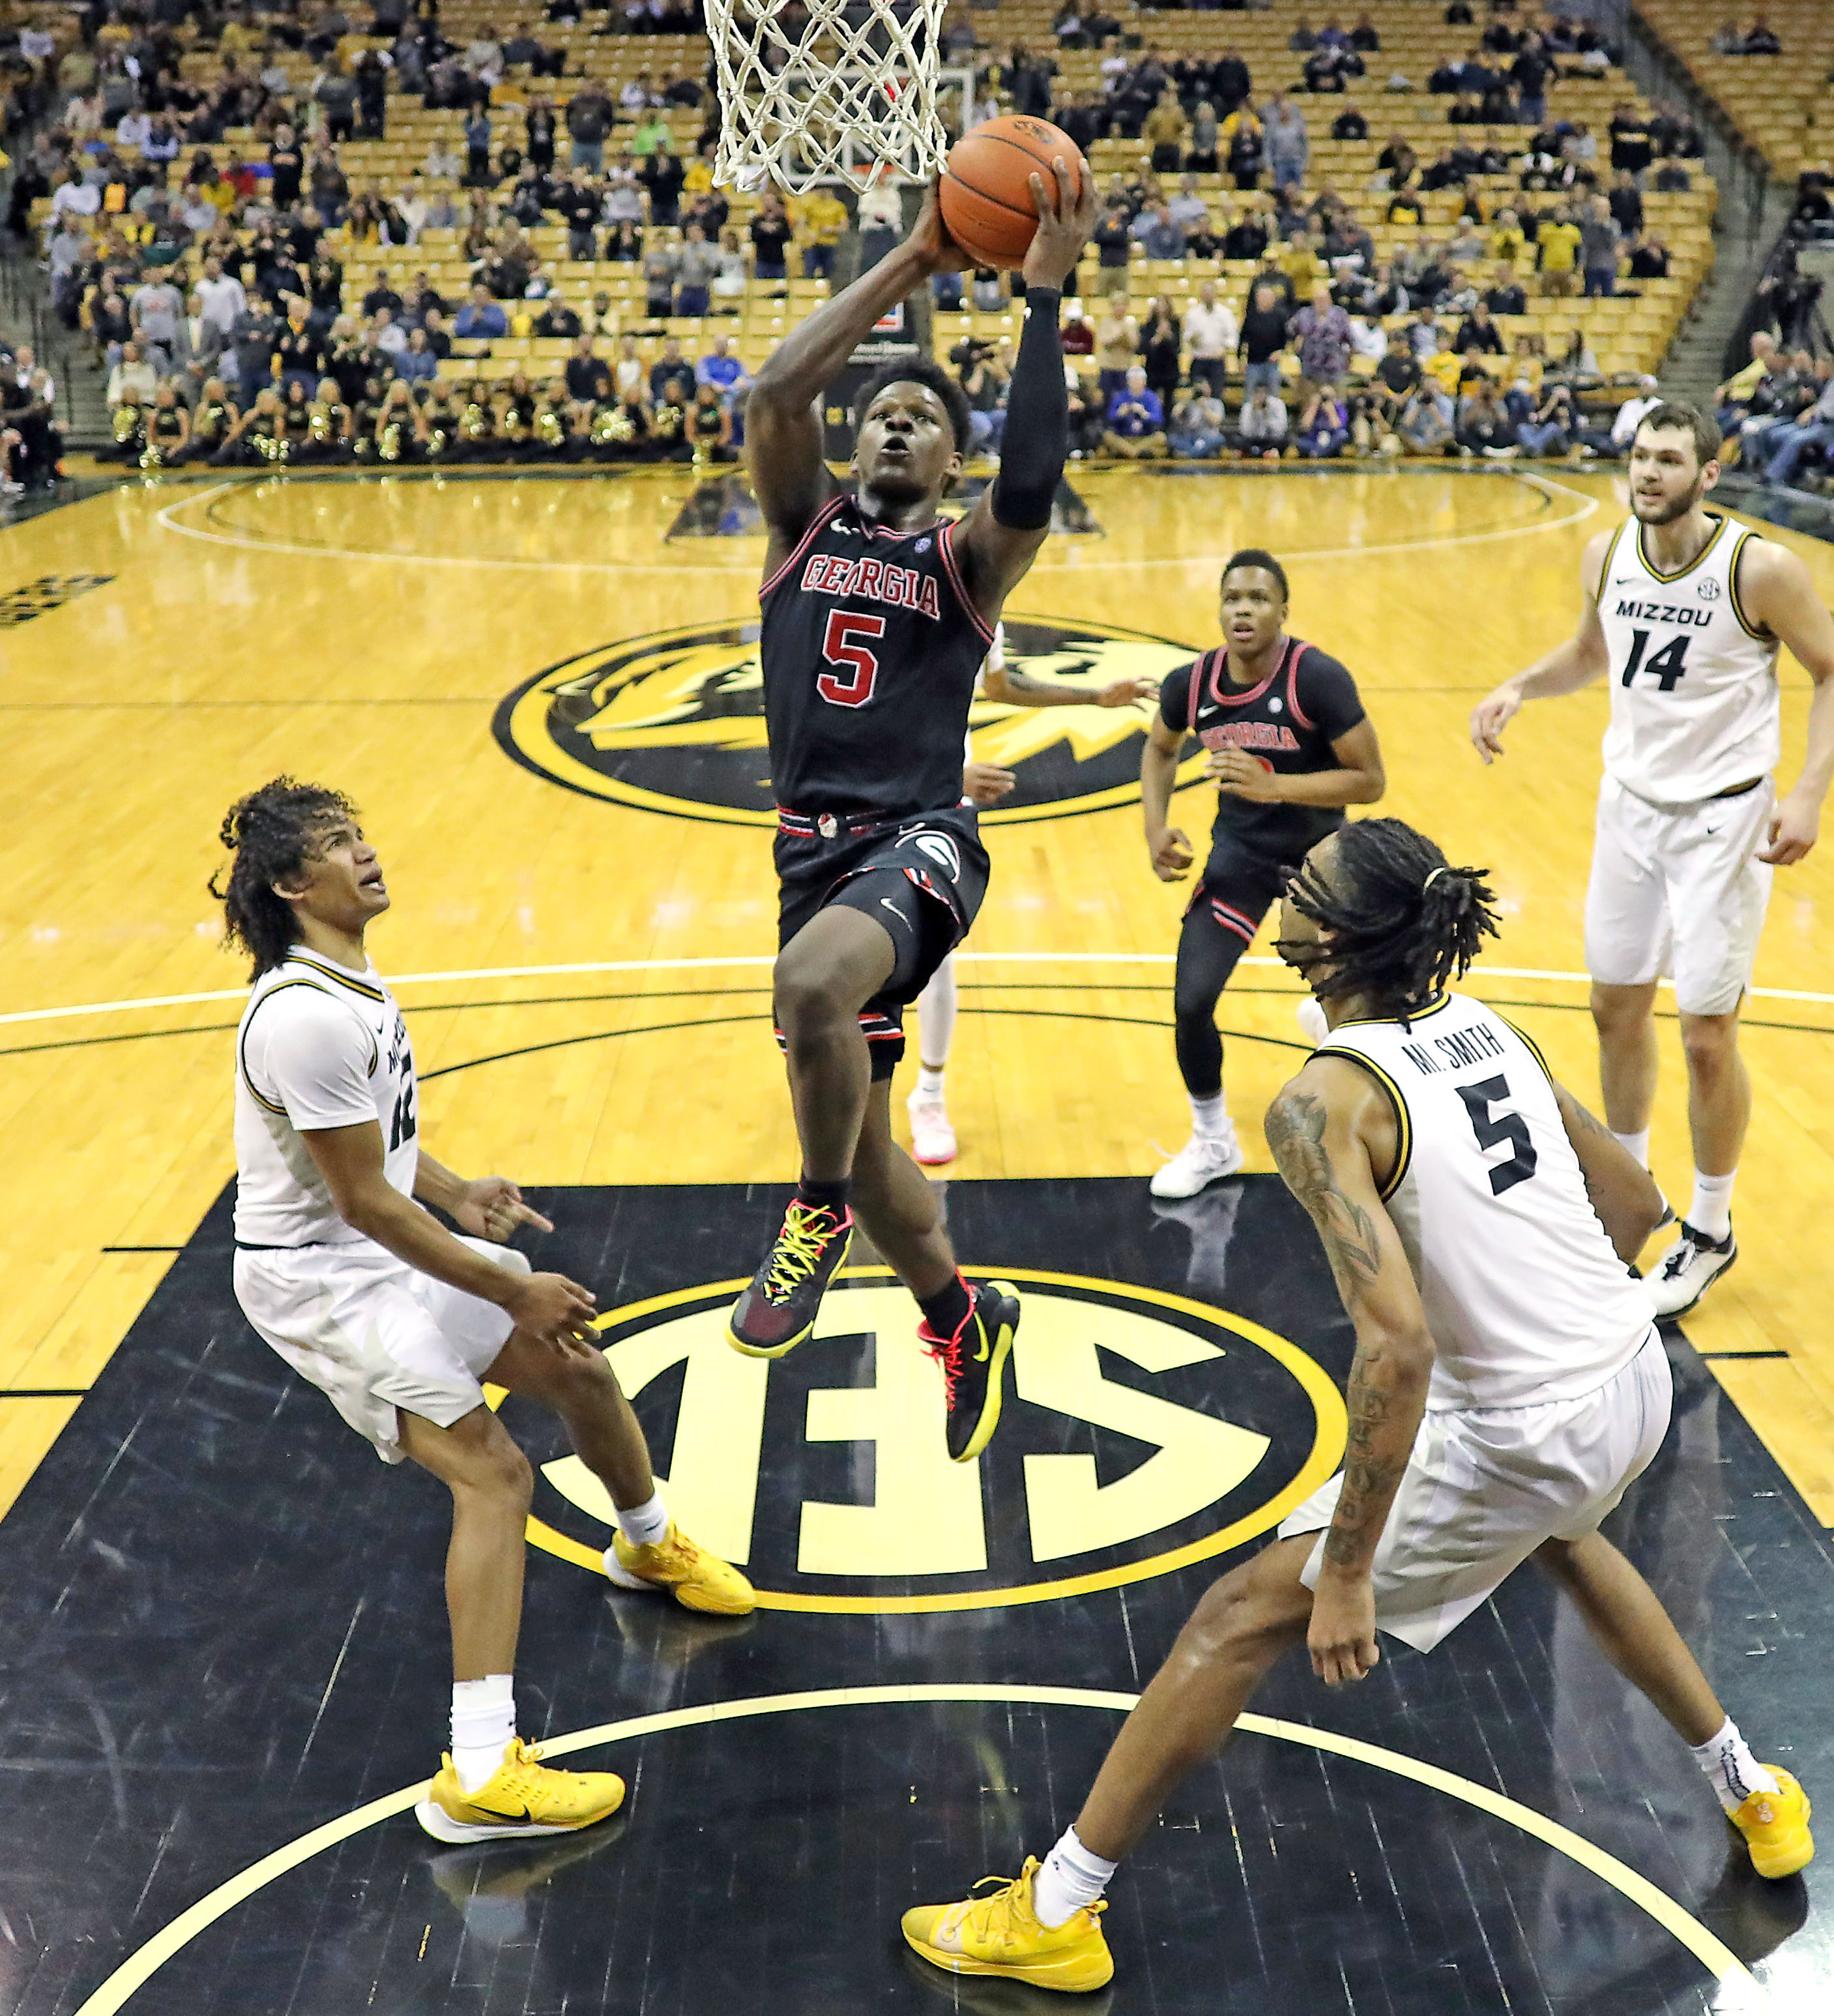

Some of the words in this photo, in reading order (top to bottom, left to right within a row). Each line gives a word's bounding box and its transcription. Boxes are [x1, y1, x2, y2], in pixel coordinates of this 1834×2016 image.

[1616, 600, 1713, 626] MIZZOU
[817, 608, 886, 709] 5
[1622, 630, 1691, 692] 14
[1434, 1023, 1505, 1069] SMITH
[1454, 1073, 1537, 1197] 5
[540, 1286, 1271, 1576] SEC
